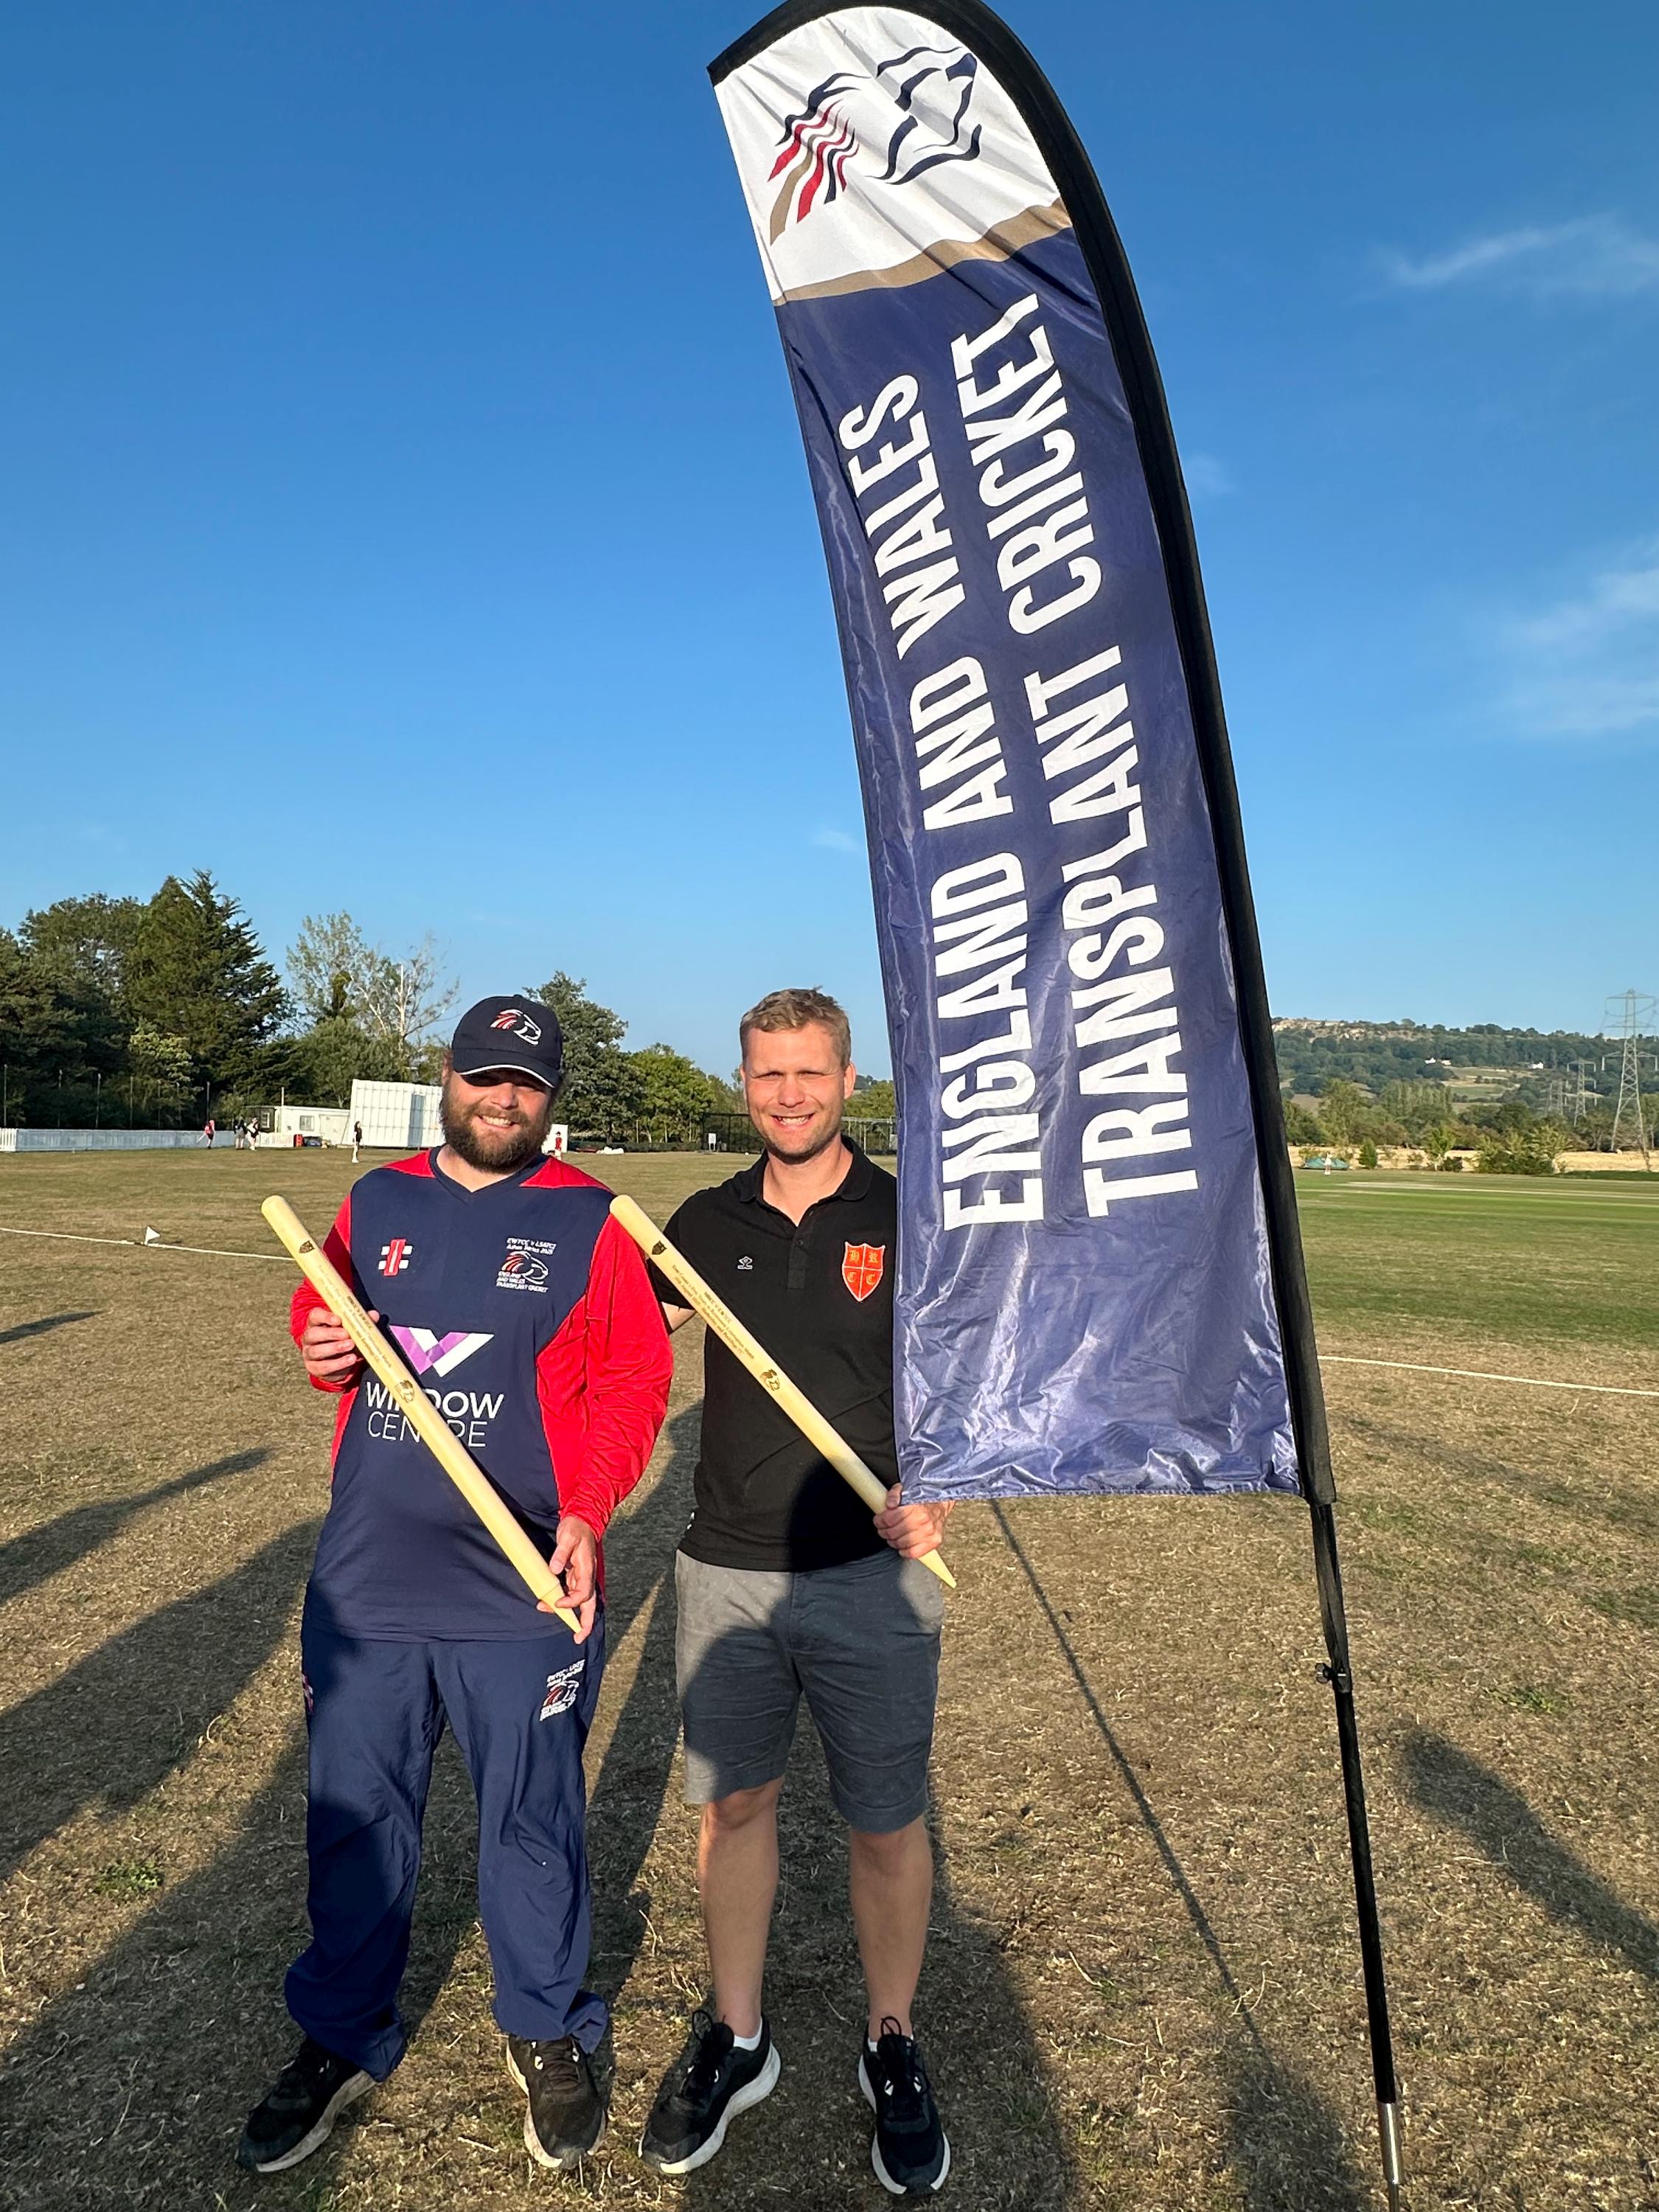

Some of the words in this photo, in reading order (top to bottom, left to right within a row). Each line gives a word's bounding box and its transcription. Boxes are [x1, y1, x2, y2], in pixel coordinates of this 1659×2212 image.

[839, 375, 965, 661] WALES
[950, 293, 1102, 636] CRICKET
[910, 656, 1014, 831] AND
[931, 853, 1045, 1232] ENGLAND
[1023, 645, 1199, 1218] TRANSPLANT
[366, 1381, 505, 1420] WIDOW
[368, 1411, 488, 1448] CENE
